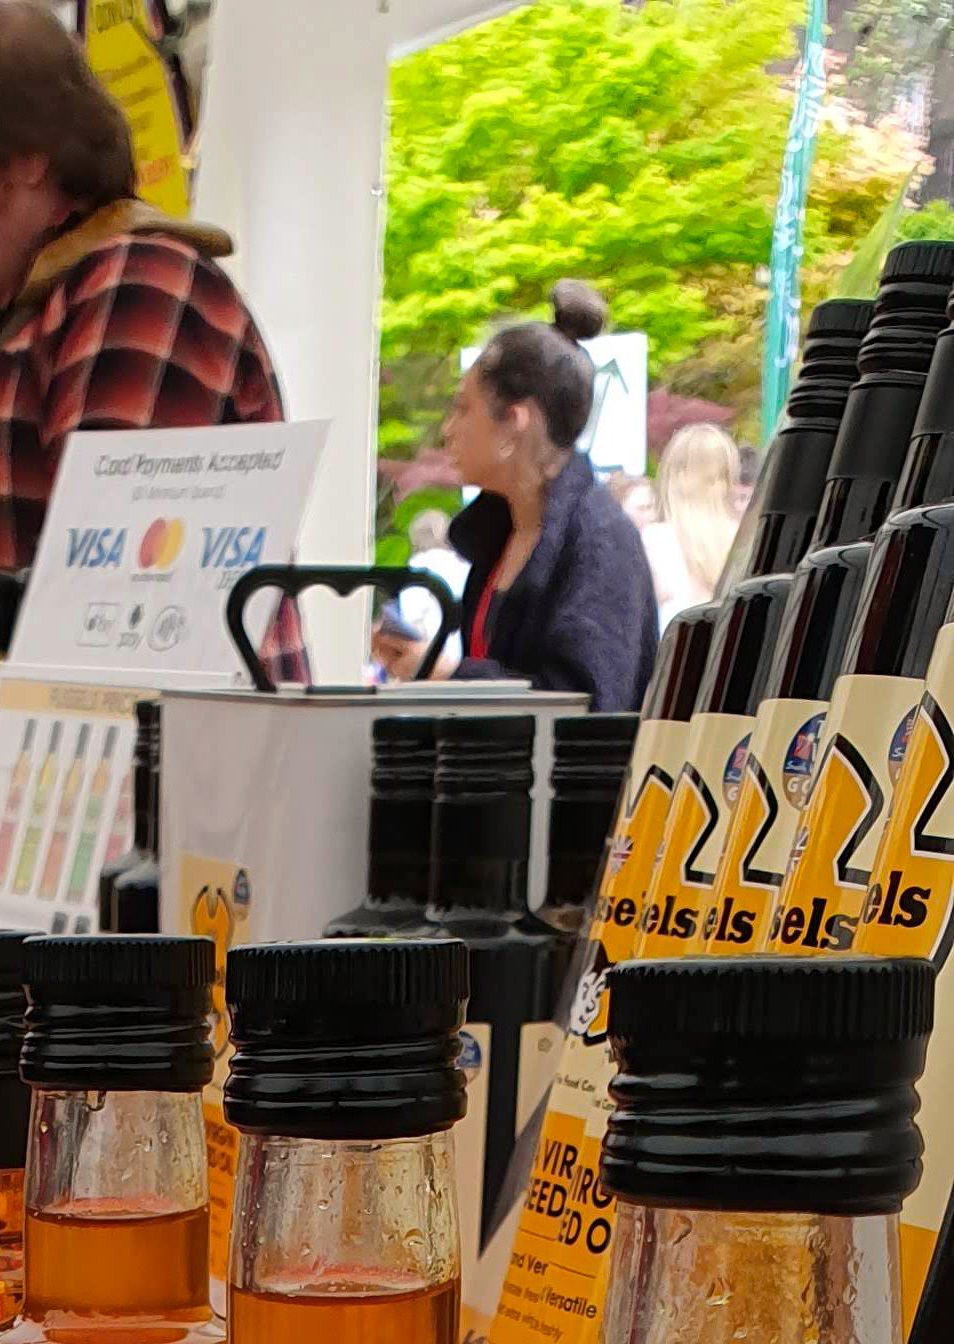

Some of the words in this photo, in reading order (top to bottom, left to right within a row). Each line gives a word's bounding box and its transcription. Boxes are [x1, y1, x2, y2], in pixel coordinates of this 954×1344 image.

[136, 452, 204, 478] Payments
[207, 448, 286, 475] Accepted
[66, 527, 129, 568] VISA
[201, 526, 267, 568] VISA
